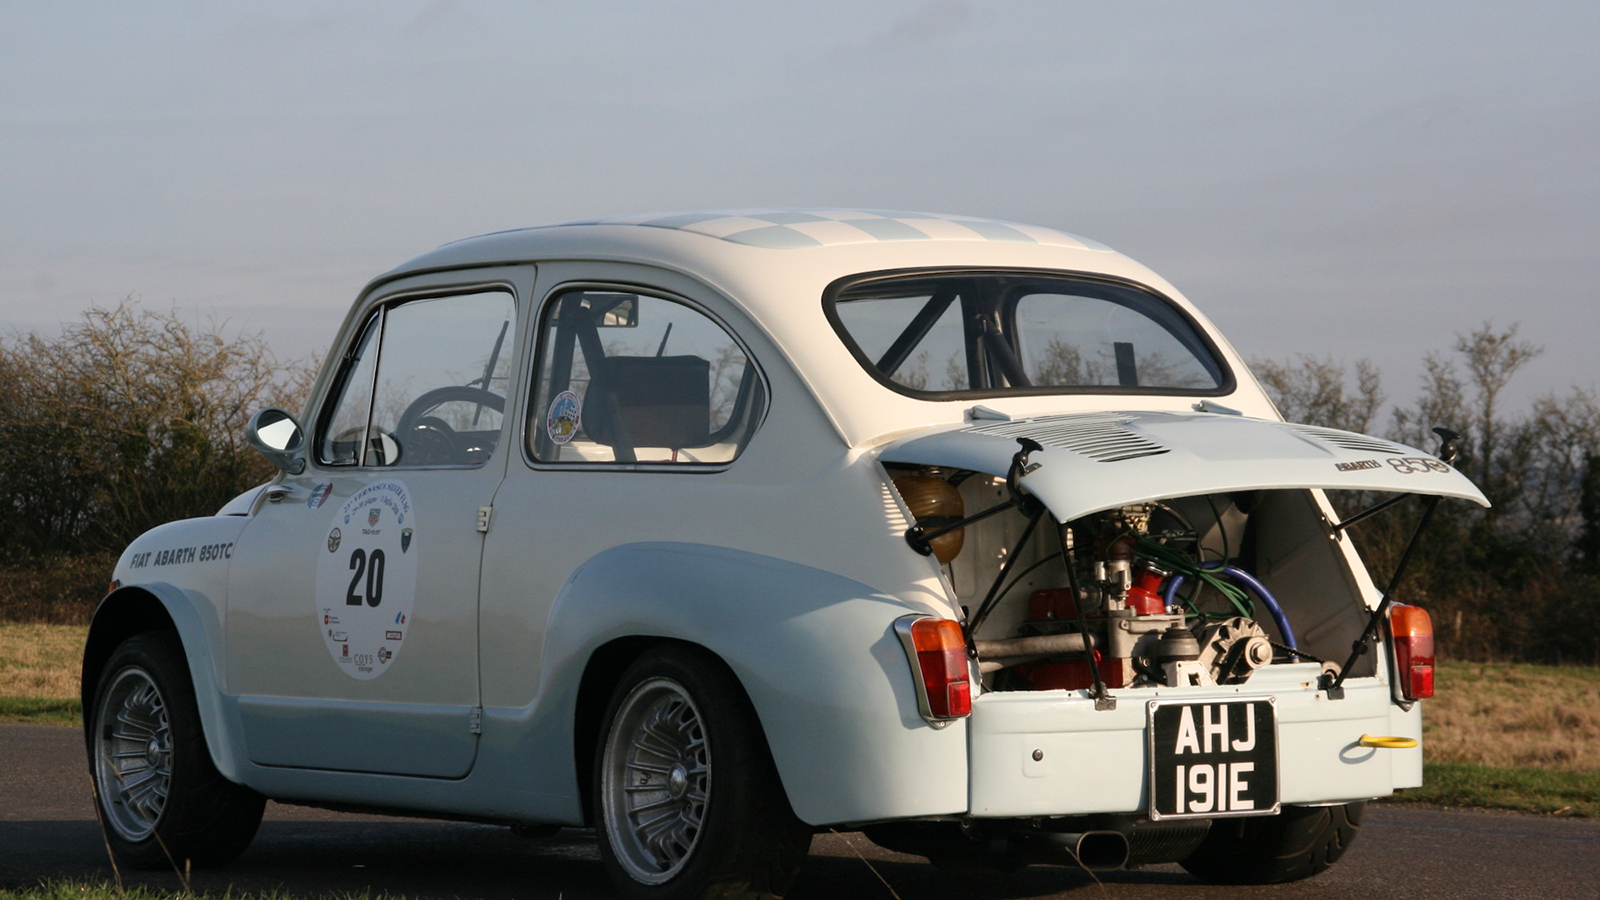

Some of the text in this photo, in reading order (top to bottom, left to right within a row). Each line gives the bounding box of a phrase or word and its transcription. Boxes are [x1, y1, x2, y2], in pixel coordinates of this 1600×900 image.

[1335, 460, 1382, 472] ABARTH
[130, 542, 233, 569] FIAT ABARTH 850TC
[346, 548, 385, 608] 20
[354, 654, 373, 664] COYS
[1175, 703, 1256, 754] AHJ
[1176, 762, 1254, 813] 191E
